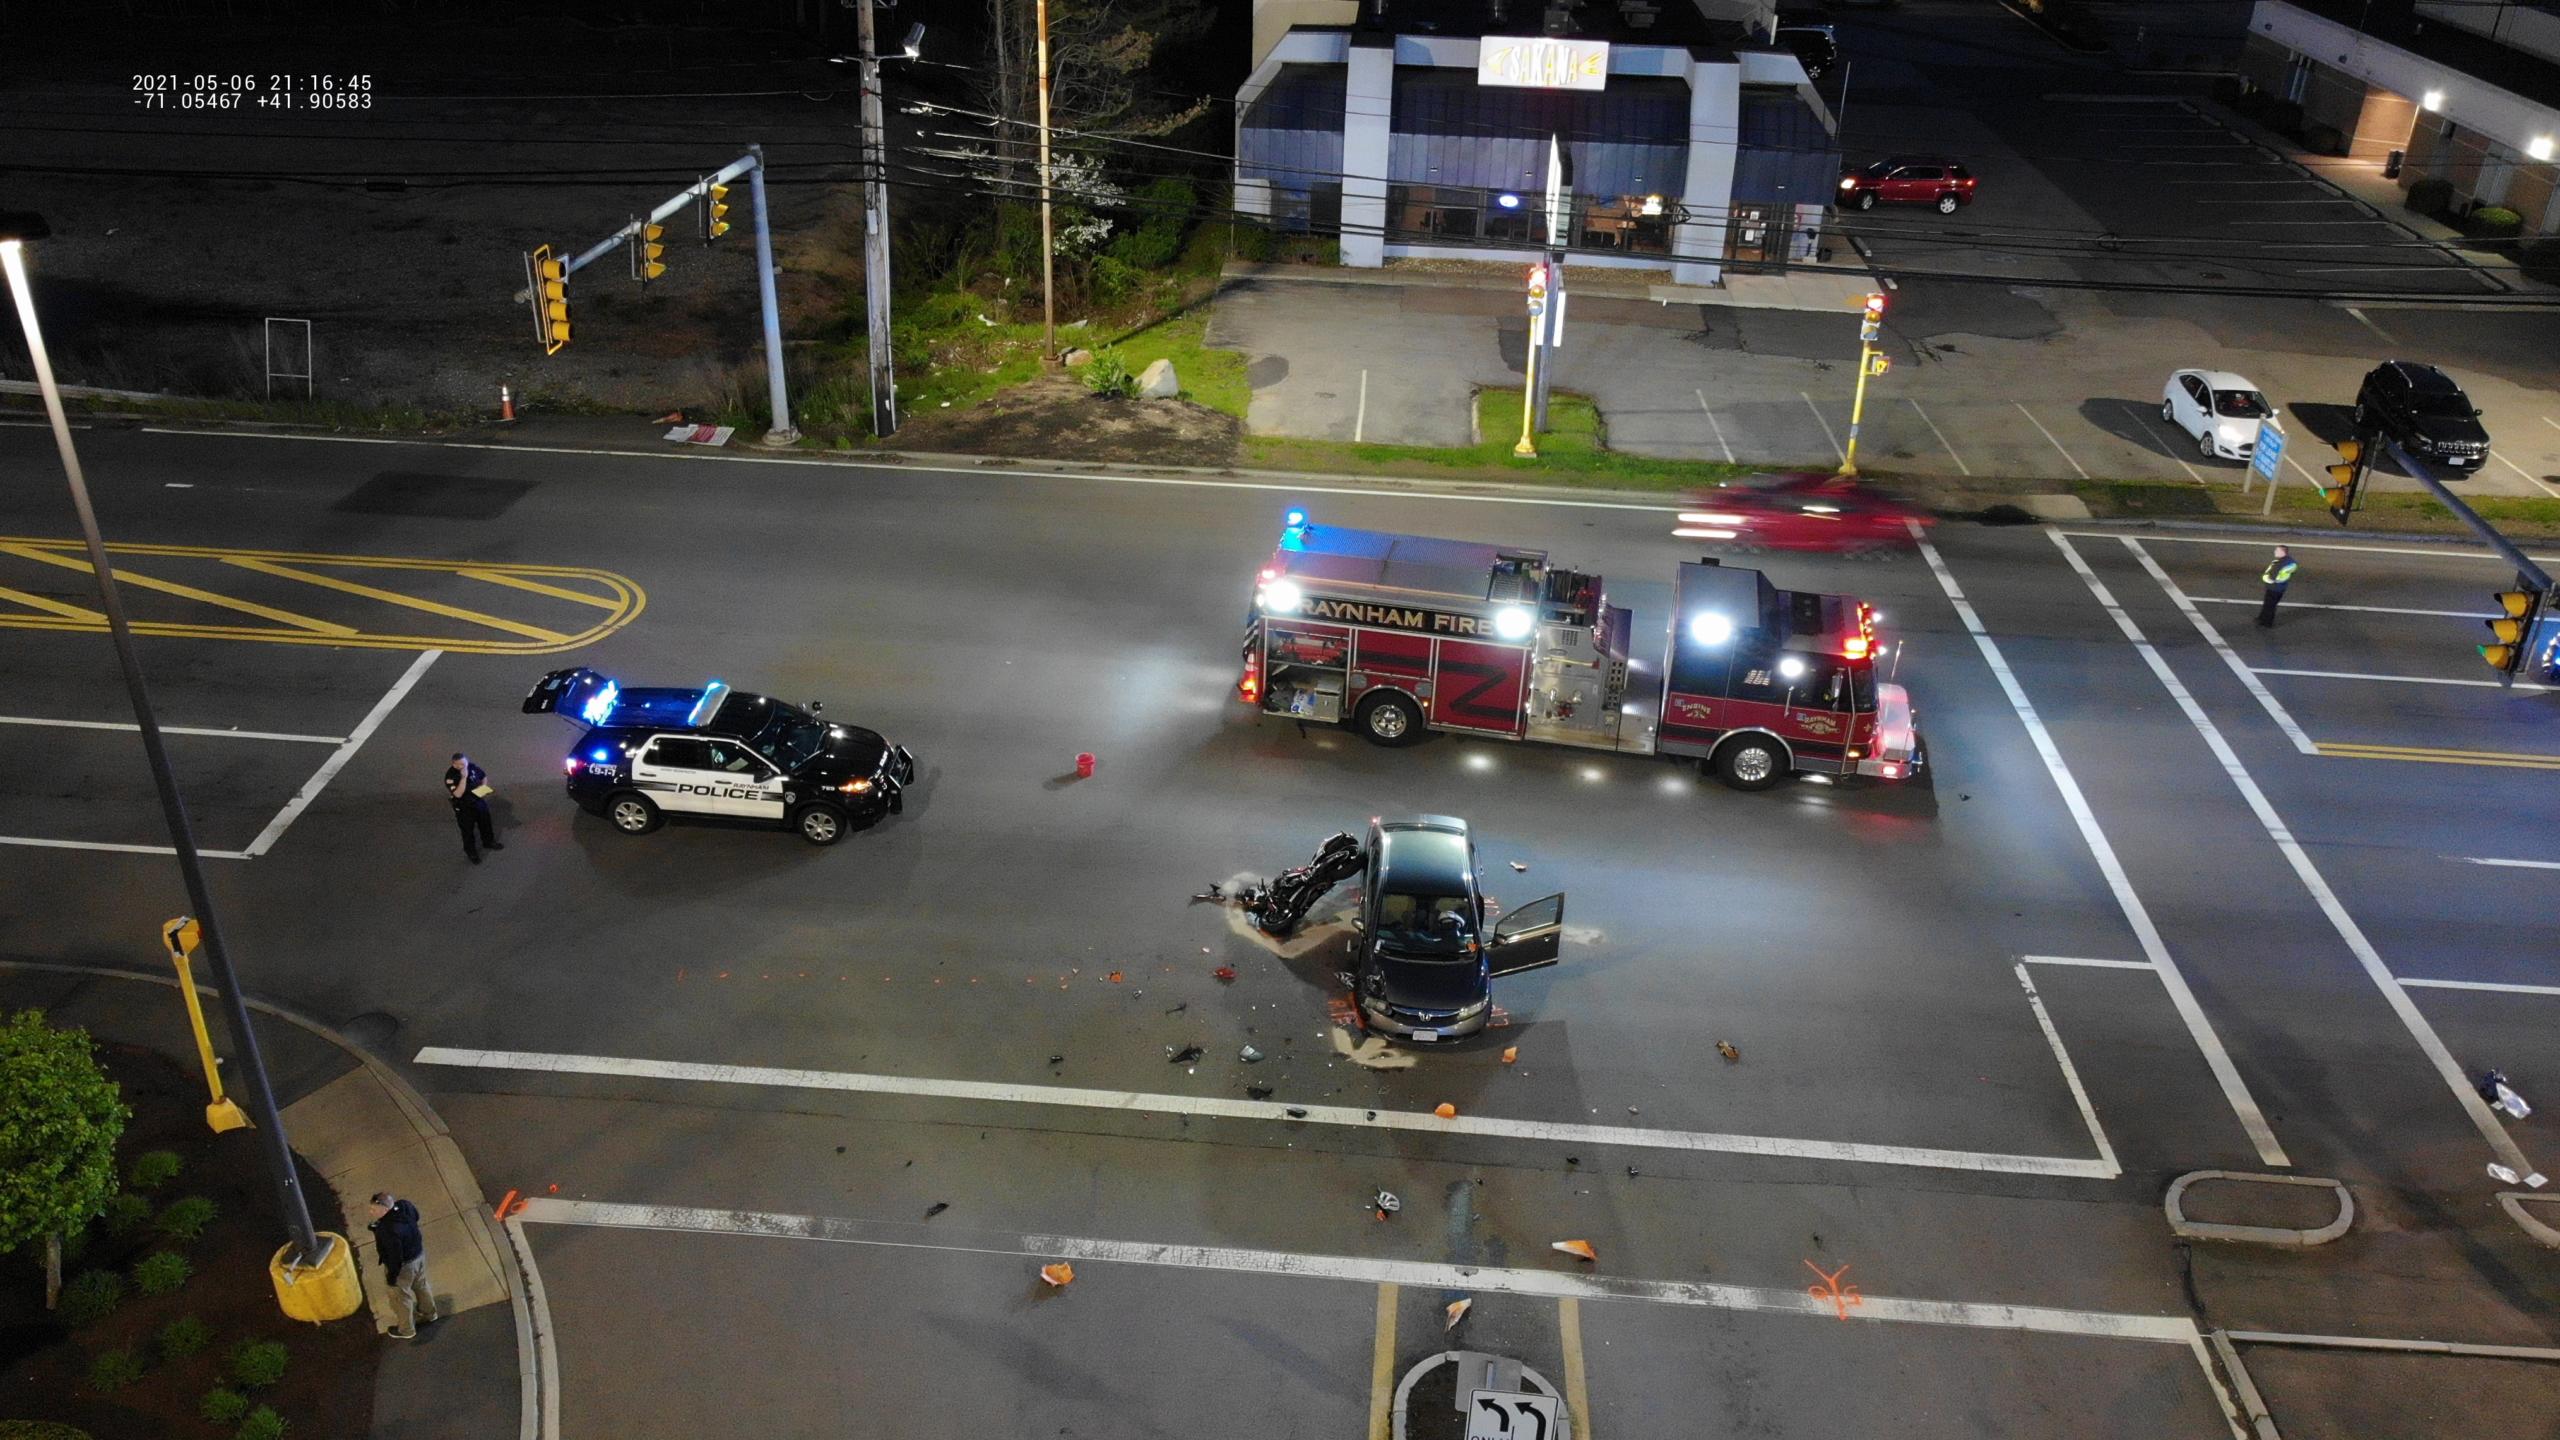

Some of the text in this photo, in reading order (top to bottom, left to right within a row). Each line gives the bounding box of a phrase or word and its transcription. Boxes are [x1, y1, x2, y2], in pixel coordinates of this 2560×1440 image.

[1510, 43, 1579, 86] SAKANA
[1298, 599, 1496, 637] RAYNHAM FIRE
[677, 783, 760, 801] POLICE
